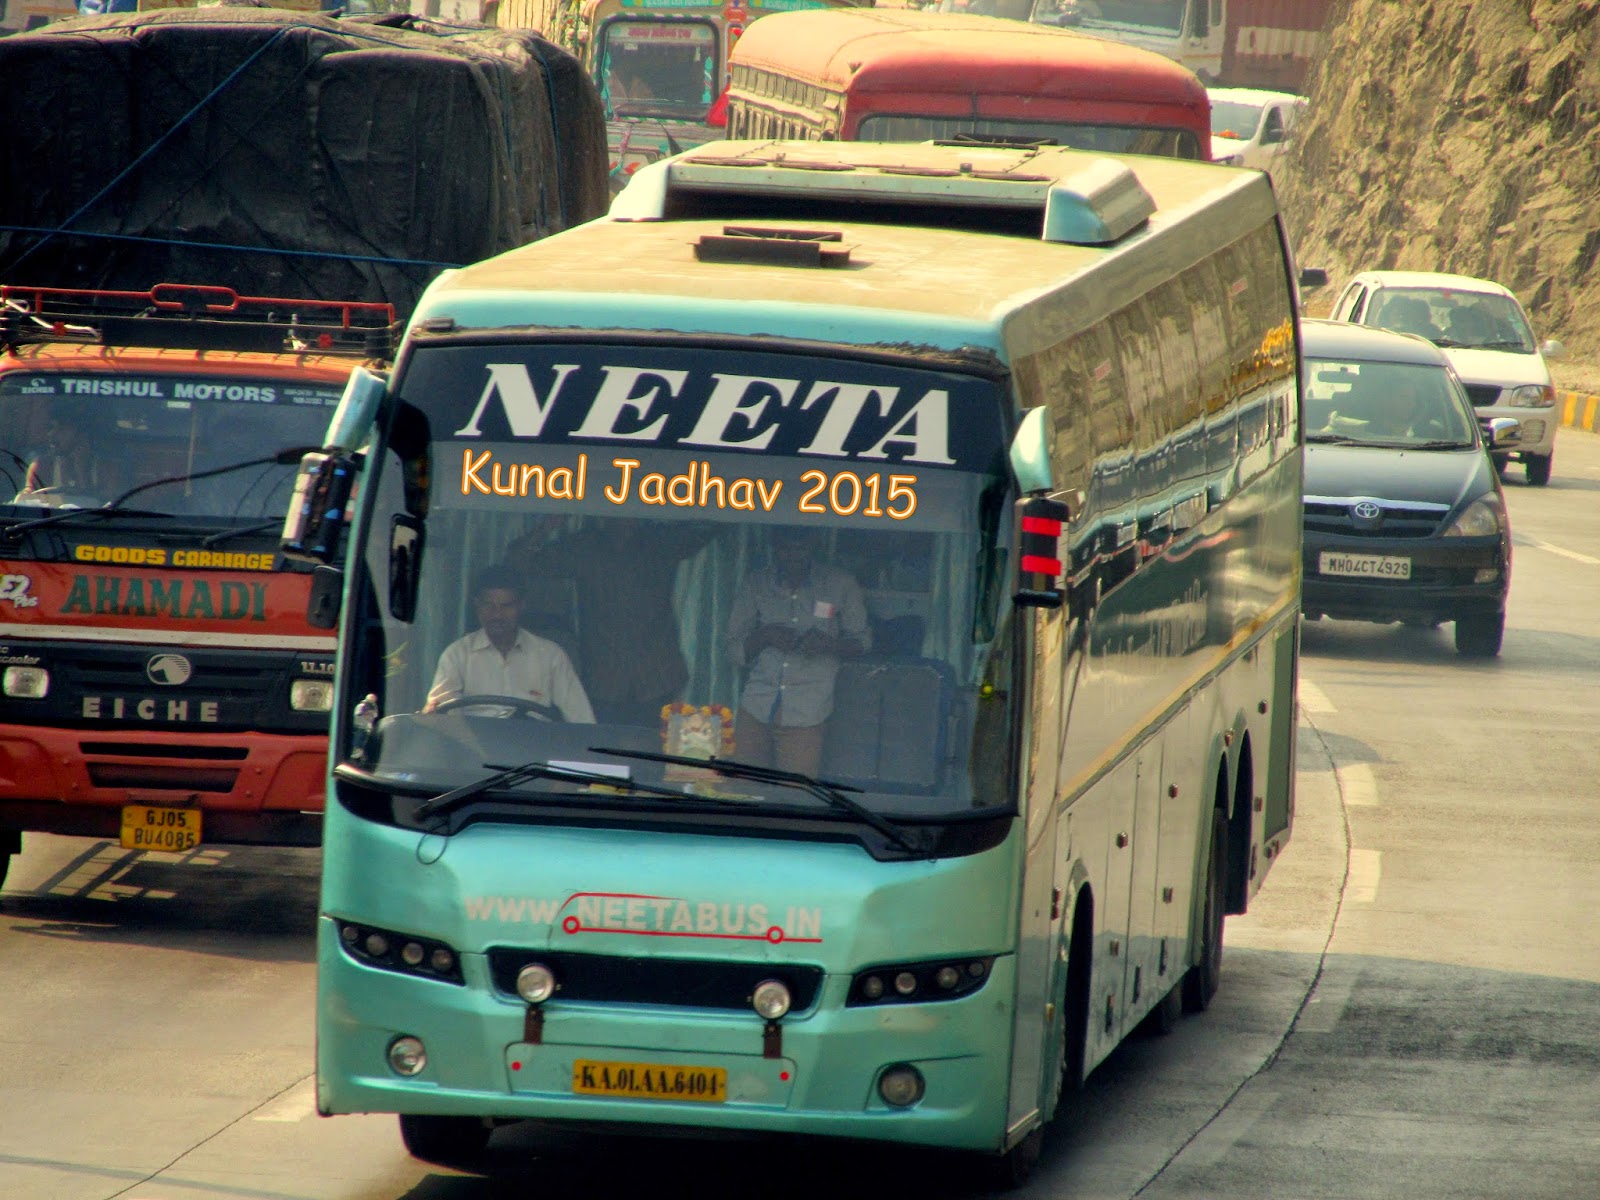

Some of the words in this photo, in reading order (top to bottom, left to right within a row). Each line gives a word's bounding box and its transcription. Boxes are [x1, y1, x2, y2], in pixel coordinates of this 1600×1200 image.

[61, 378, 164, 397] TRISHUL
[174, 383, 276, 402] MOTORS
[454, 363, 957, 465] NEETA
[75, 545, 166, 565] GOODS
[172, 550, 275, 571] CARRIAGE
[1329, 558, 1409, 576] MH04CT4929
[60, 574, 268, 621] AHAMADI
[82, 697, 218, 722] EICHE
[146, 809, 187, 828] GJ05
[134, 827, 195, 849] BU4085
